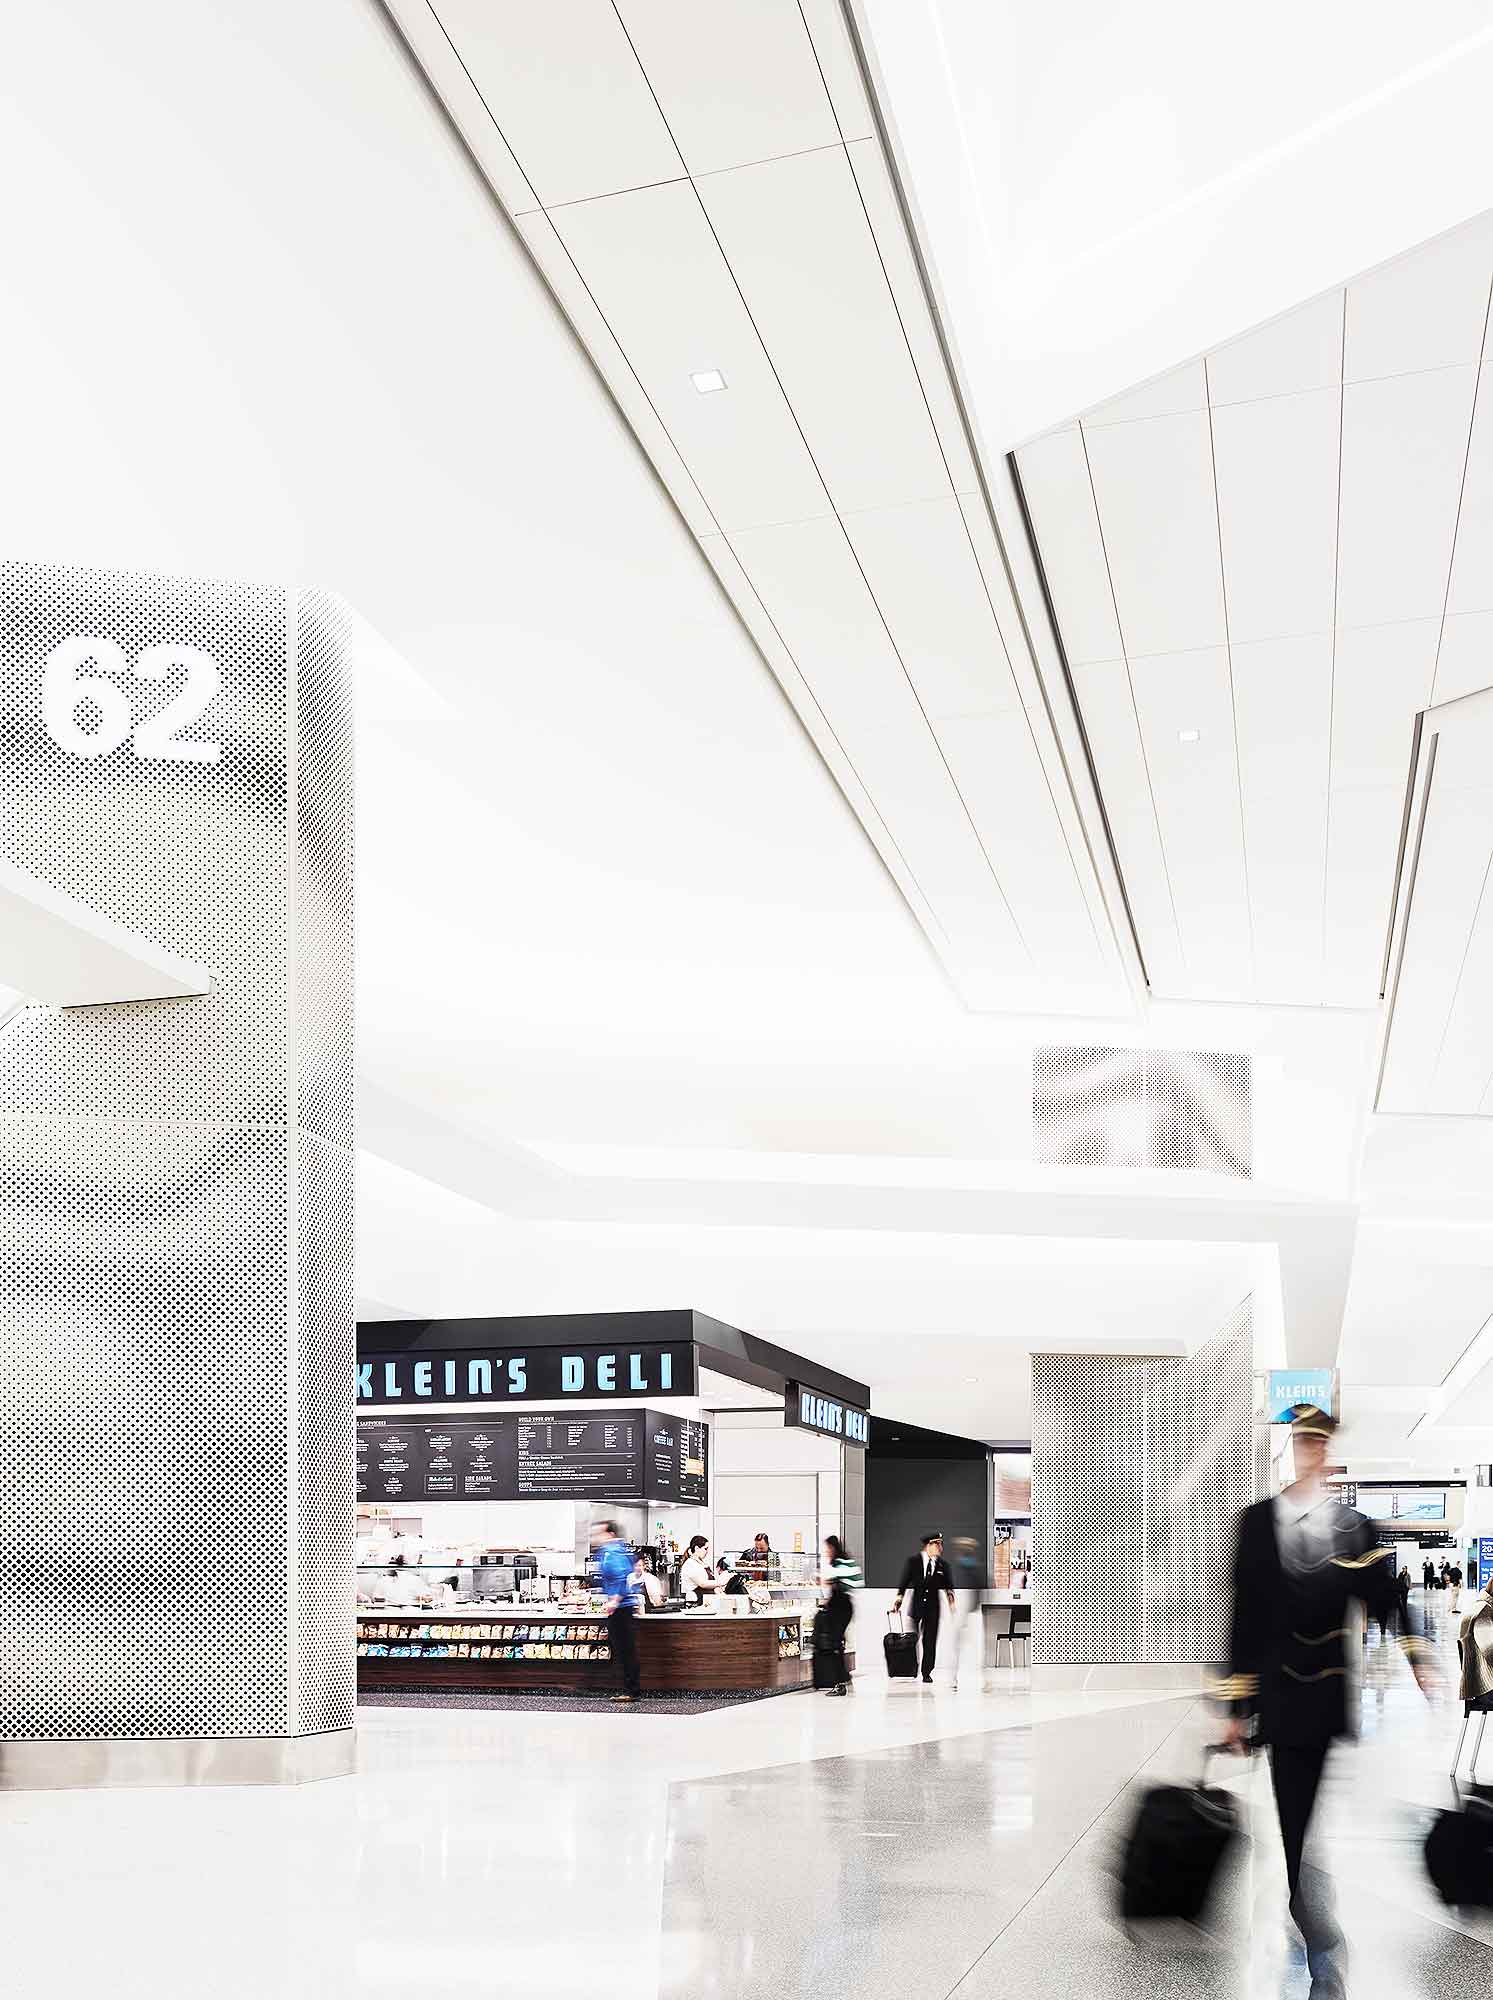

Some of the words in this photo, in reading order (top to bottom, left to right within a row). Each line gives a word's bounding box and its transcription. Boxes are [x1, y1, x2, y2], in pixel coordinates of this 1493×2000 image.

[43, 635, 219, 761] 62
[356, 1357, 526, 1398] KLEIN'S
[562, 1353, 672, 1392] DELI
[801, 1392, 843, 1434] KLEIN'S
[845, 1409, 868, 1443] DELI
